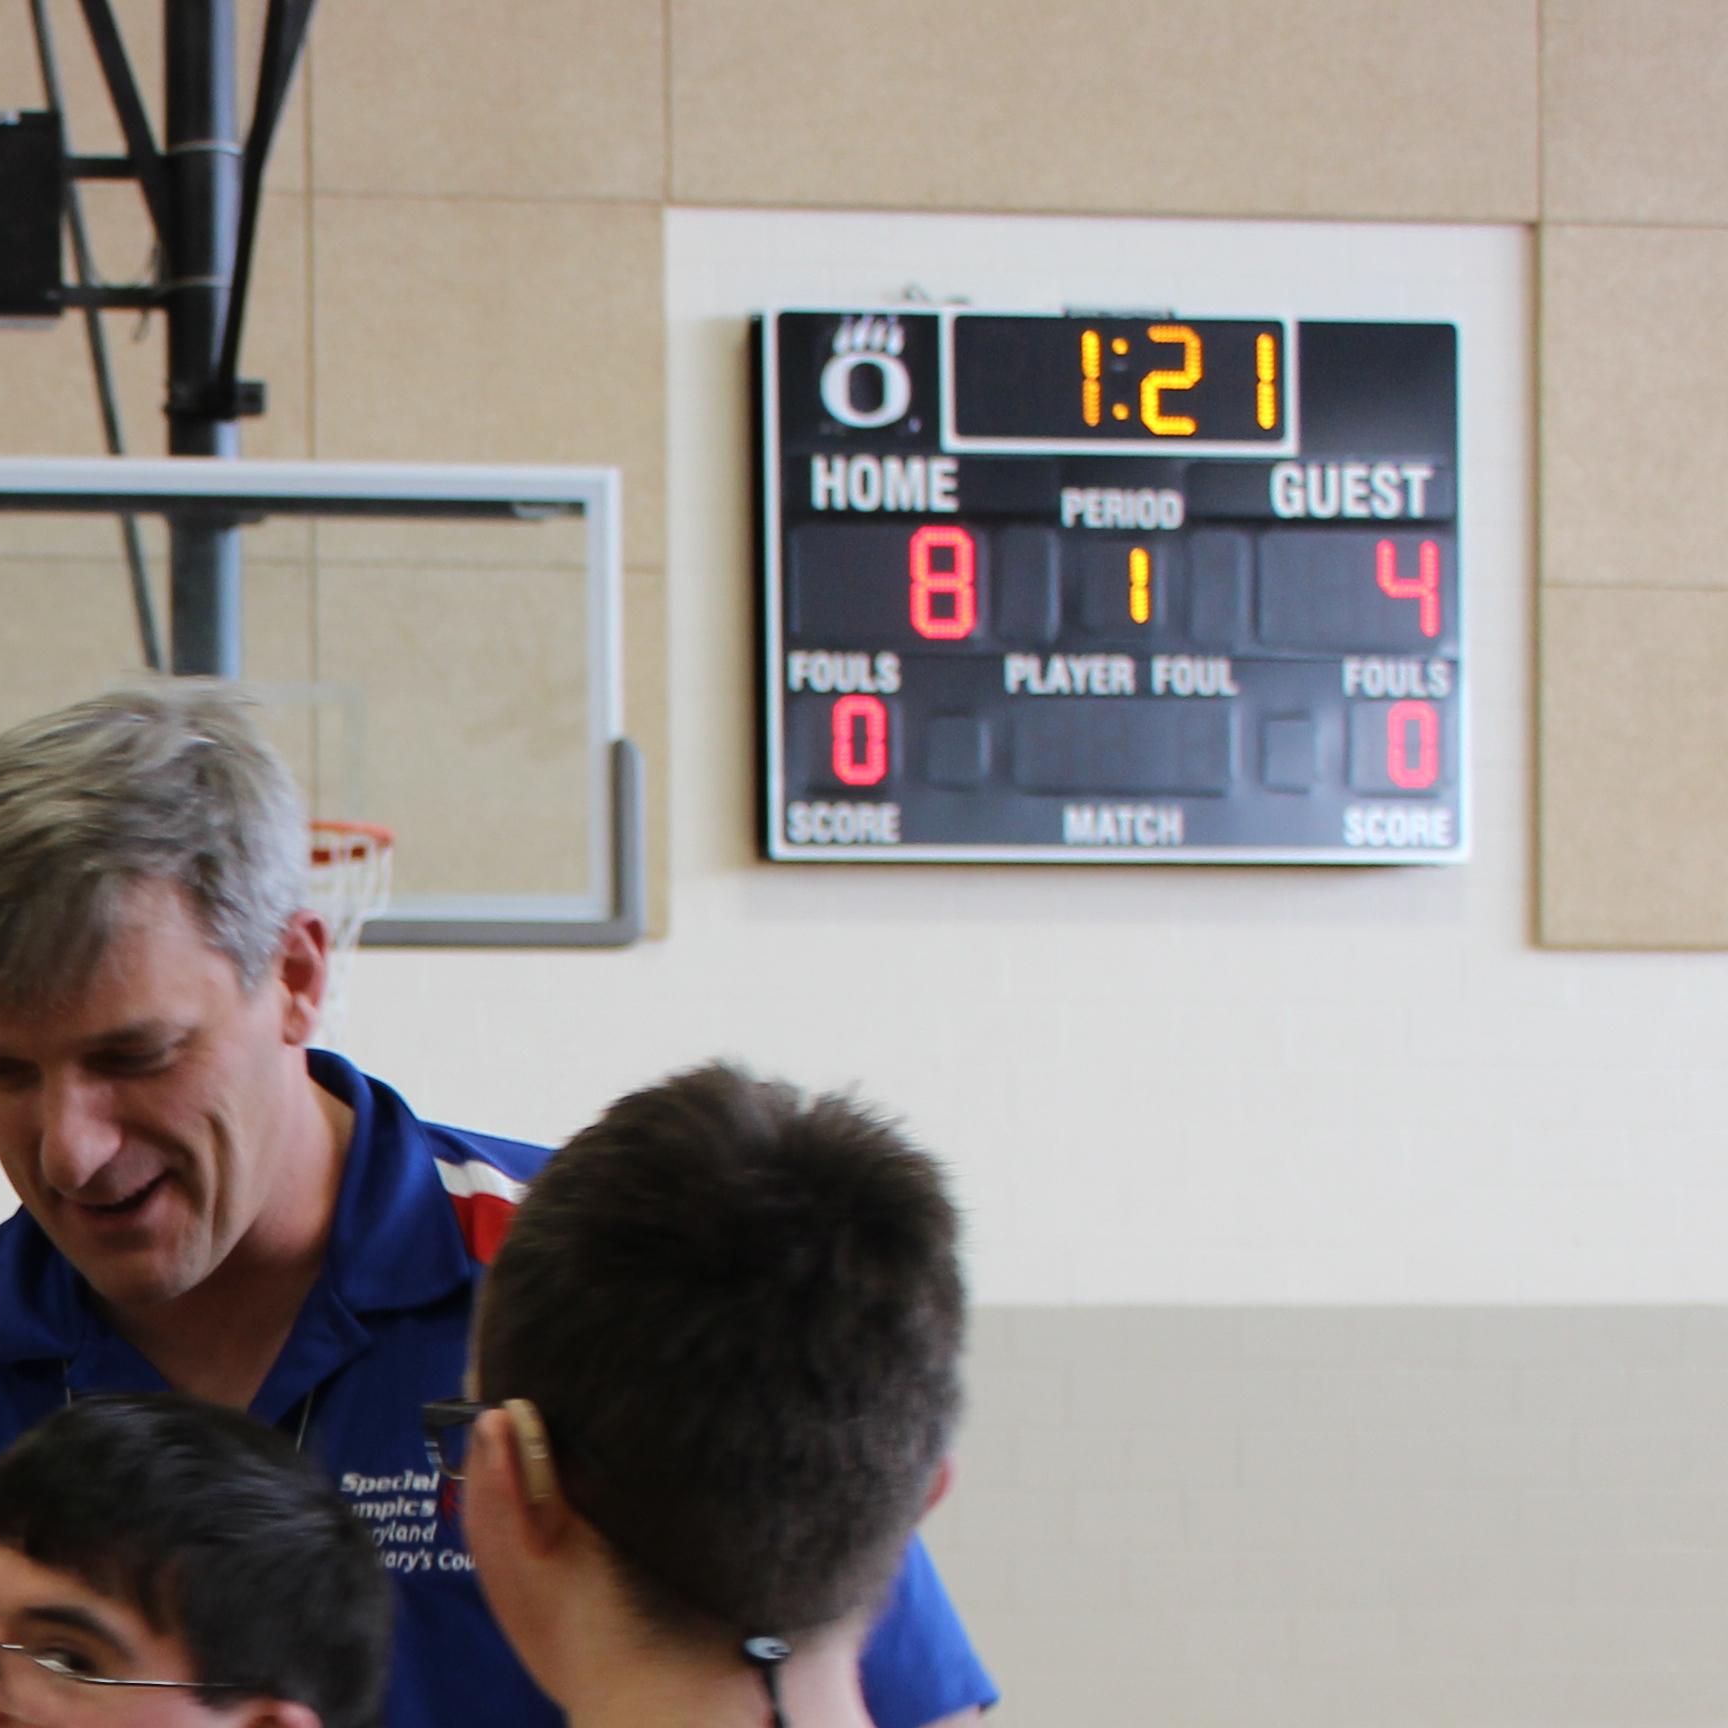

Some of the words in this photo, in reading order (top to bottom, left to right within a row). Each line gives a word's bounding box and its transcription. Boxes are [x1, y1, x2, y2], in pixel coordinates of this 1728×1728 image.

[1081, 325, 1275, 436] 1:21
[810, 455, 959, 512] HOME
[1270, 463, 1433, 519] GUEST
[1061, 488, 1185, 530] PERIOD
[910, 525, 976, 640] 8
[1129, 547, 1150, 623] 1
[1376, 540, 1439, 638] 4
[788, 651, 901, 694] FOULS
[1004, 653, 1134, 694] PLAYER
[1151, 655, 1239, 695] FOUL
[1343, 656, 1452, 698] FOULS
[832, 695, 887, 786] 0
[1387, 700, 1438, 788] 0
[788, 803, 901, 845] SCORE
[1063, 804, 1185, 845] MATCH
[1344, 805, 1453, 846] SCORE
[340, 1469, 440, 1496] Special
[352, 1496, 438, 1521] mpics
[372, 1520, 437, 1547] ryland
[379, 1547, 433, 1573] ary's
[438, 1549, 476, 1572] Cou
